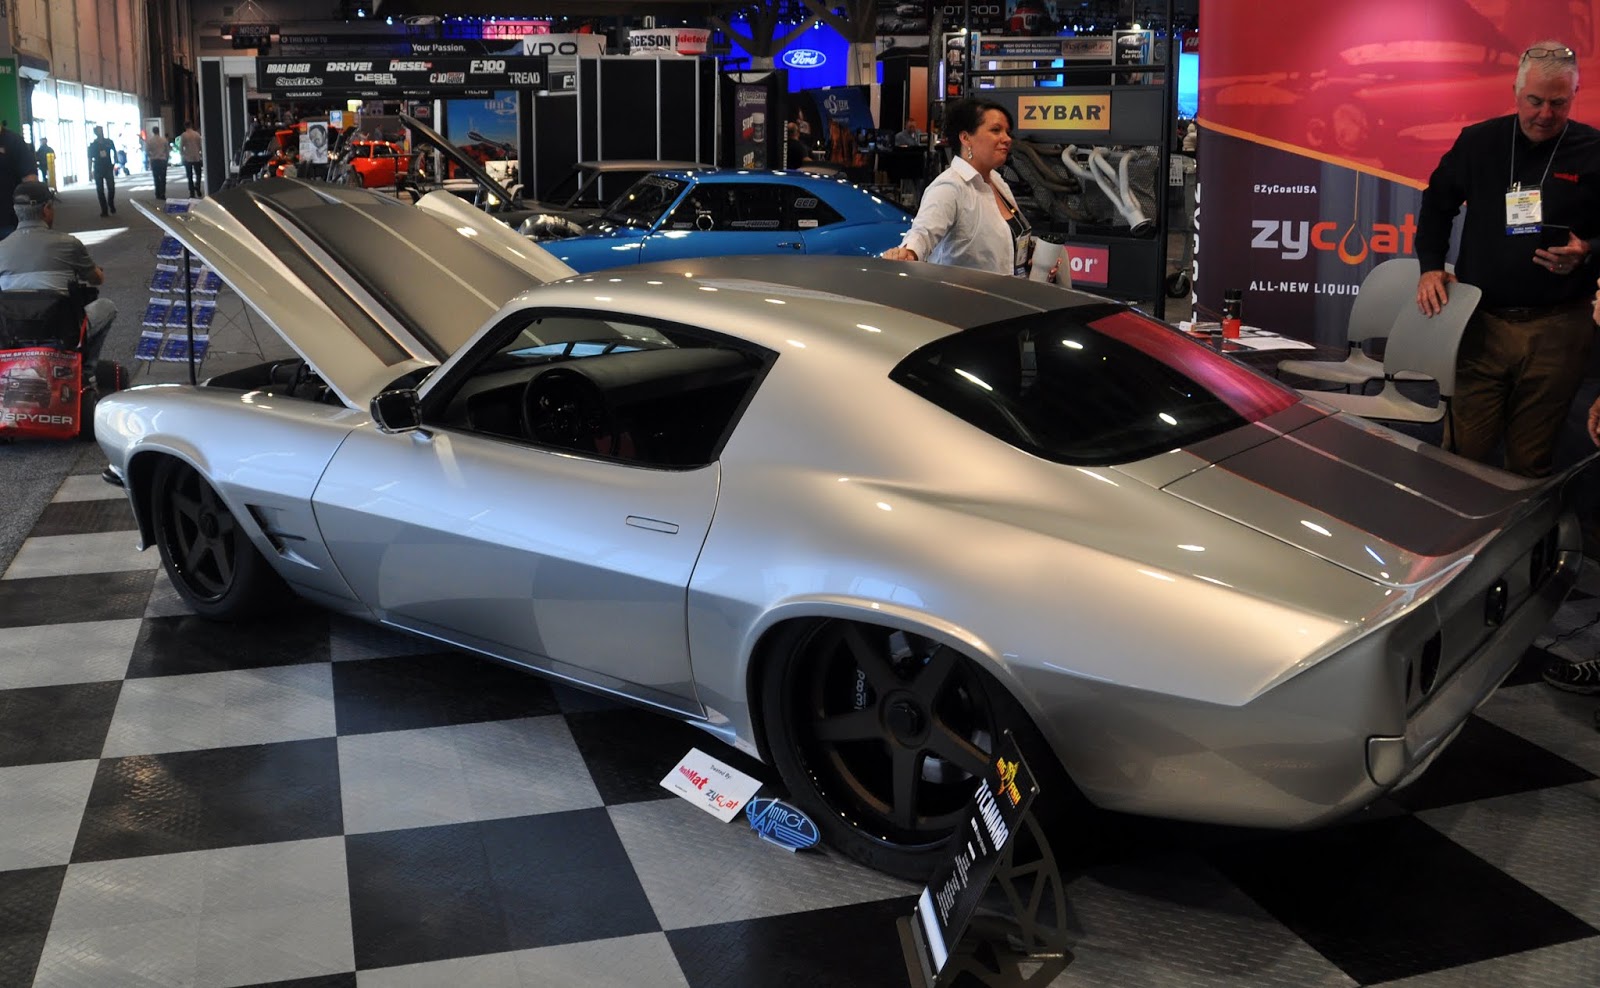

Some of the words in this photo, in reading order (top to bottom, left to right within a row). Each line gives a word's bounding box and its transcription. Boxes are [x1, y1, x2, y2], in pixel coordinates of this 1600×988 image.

[239, 26, 270, 35] NASCAR
[791, 50, 818, 65] Ford
[267, 64, 285, 73] DRAG
[287, 64, 310, 73] RACER
[508, 72, 540, 84] TREAD
[1253, 184, 1317, 195] @ZyCoatUSA
[1250, 281, 1309, 292] ALL-NEW
[1314, 283, 1359, 296] LIQUID
[6, 413, 73, 425] SPYDER
